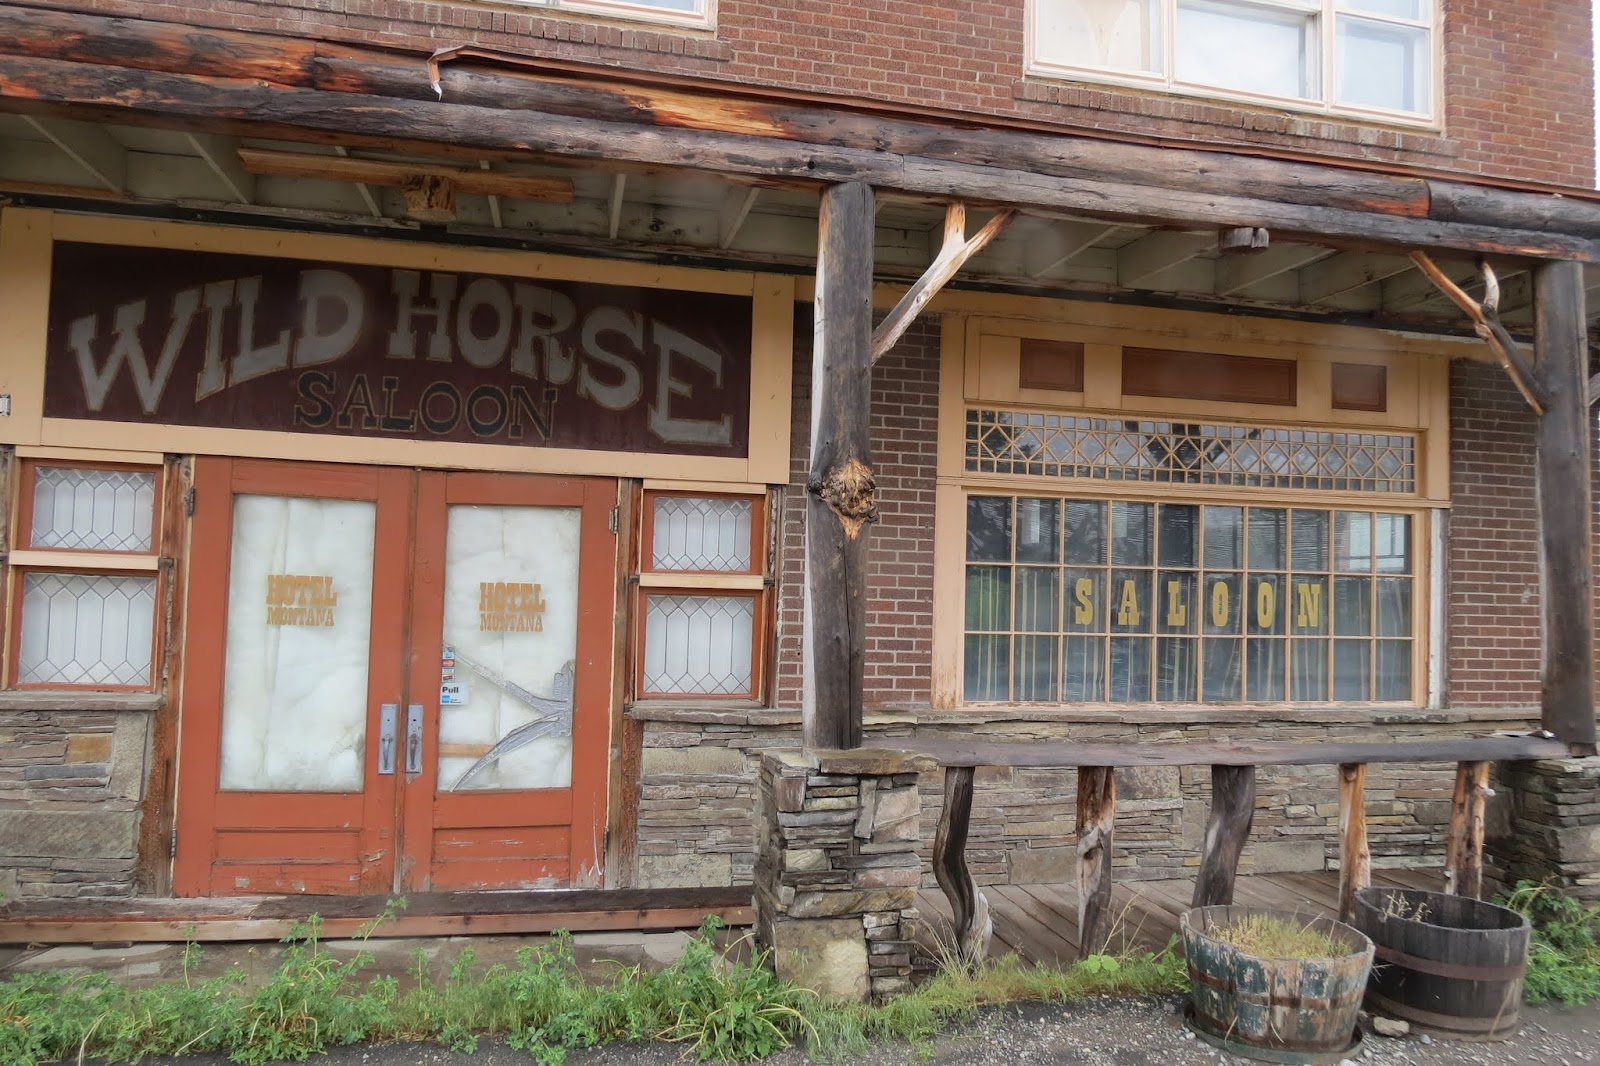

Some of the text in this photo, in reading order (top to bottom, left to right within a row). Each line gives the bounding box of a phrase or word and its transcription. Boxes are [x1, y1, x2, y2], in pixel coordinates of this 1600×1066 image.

[68, 269, 733, 447] WILD HORSE
[294, 370, 558, 440] SALOON
[266, 575, 338, 606] HOTEL
[479, 582, 546, 612] HOTEL
[1075, 578, 1321, 628] SALOON
[267, 607, 335, 626] MONTANA
[480, 613, 544, 632] MONTANA
